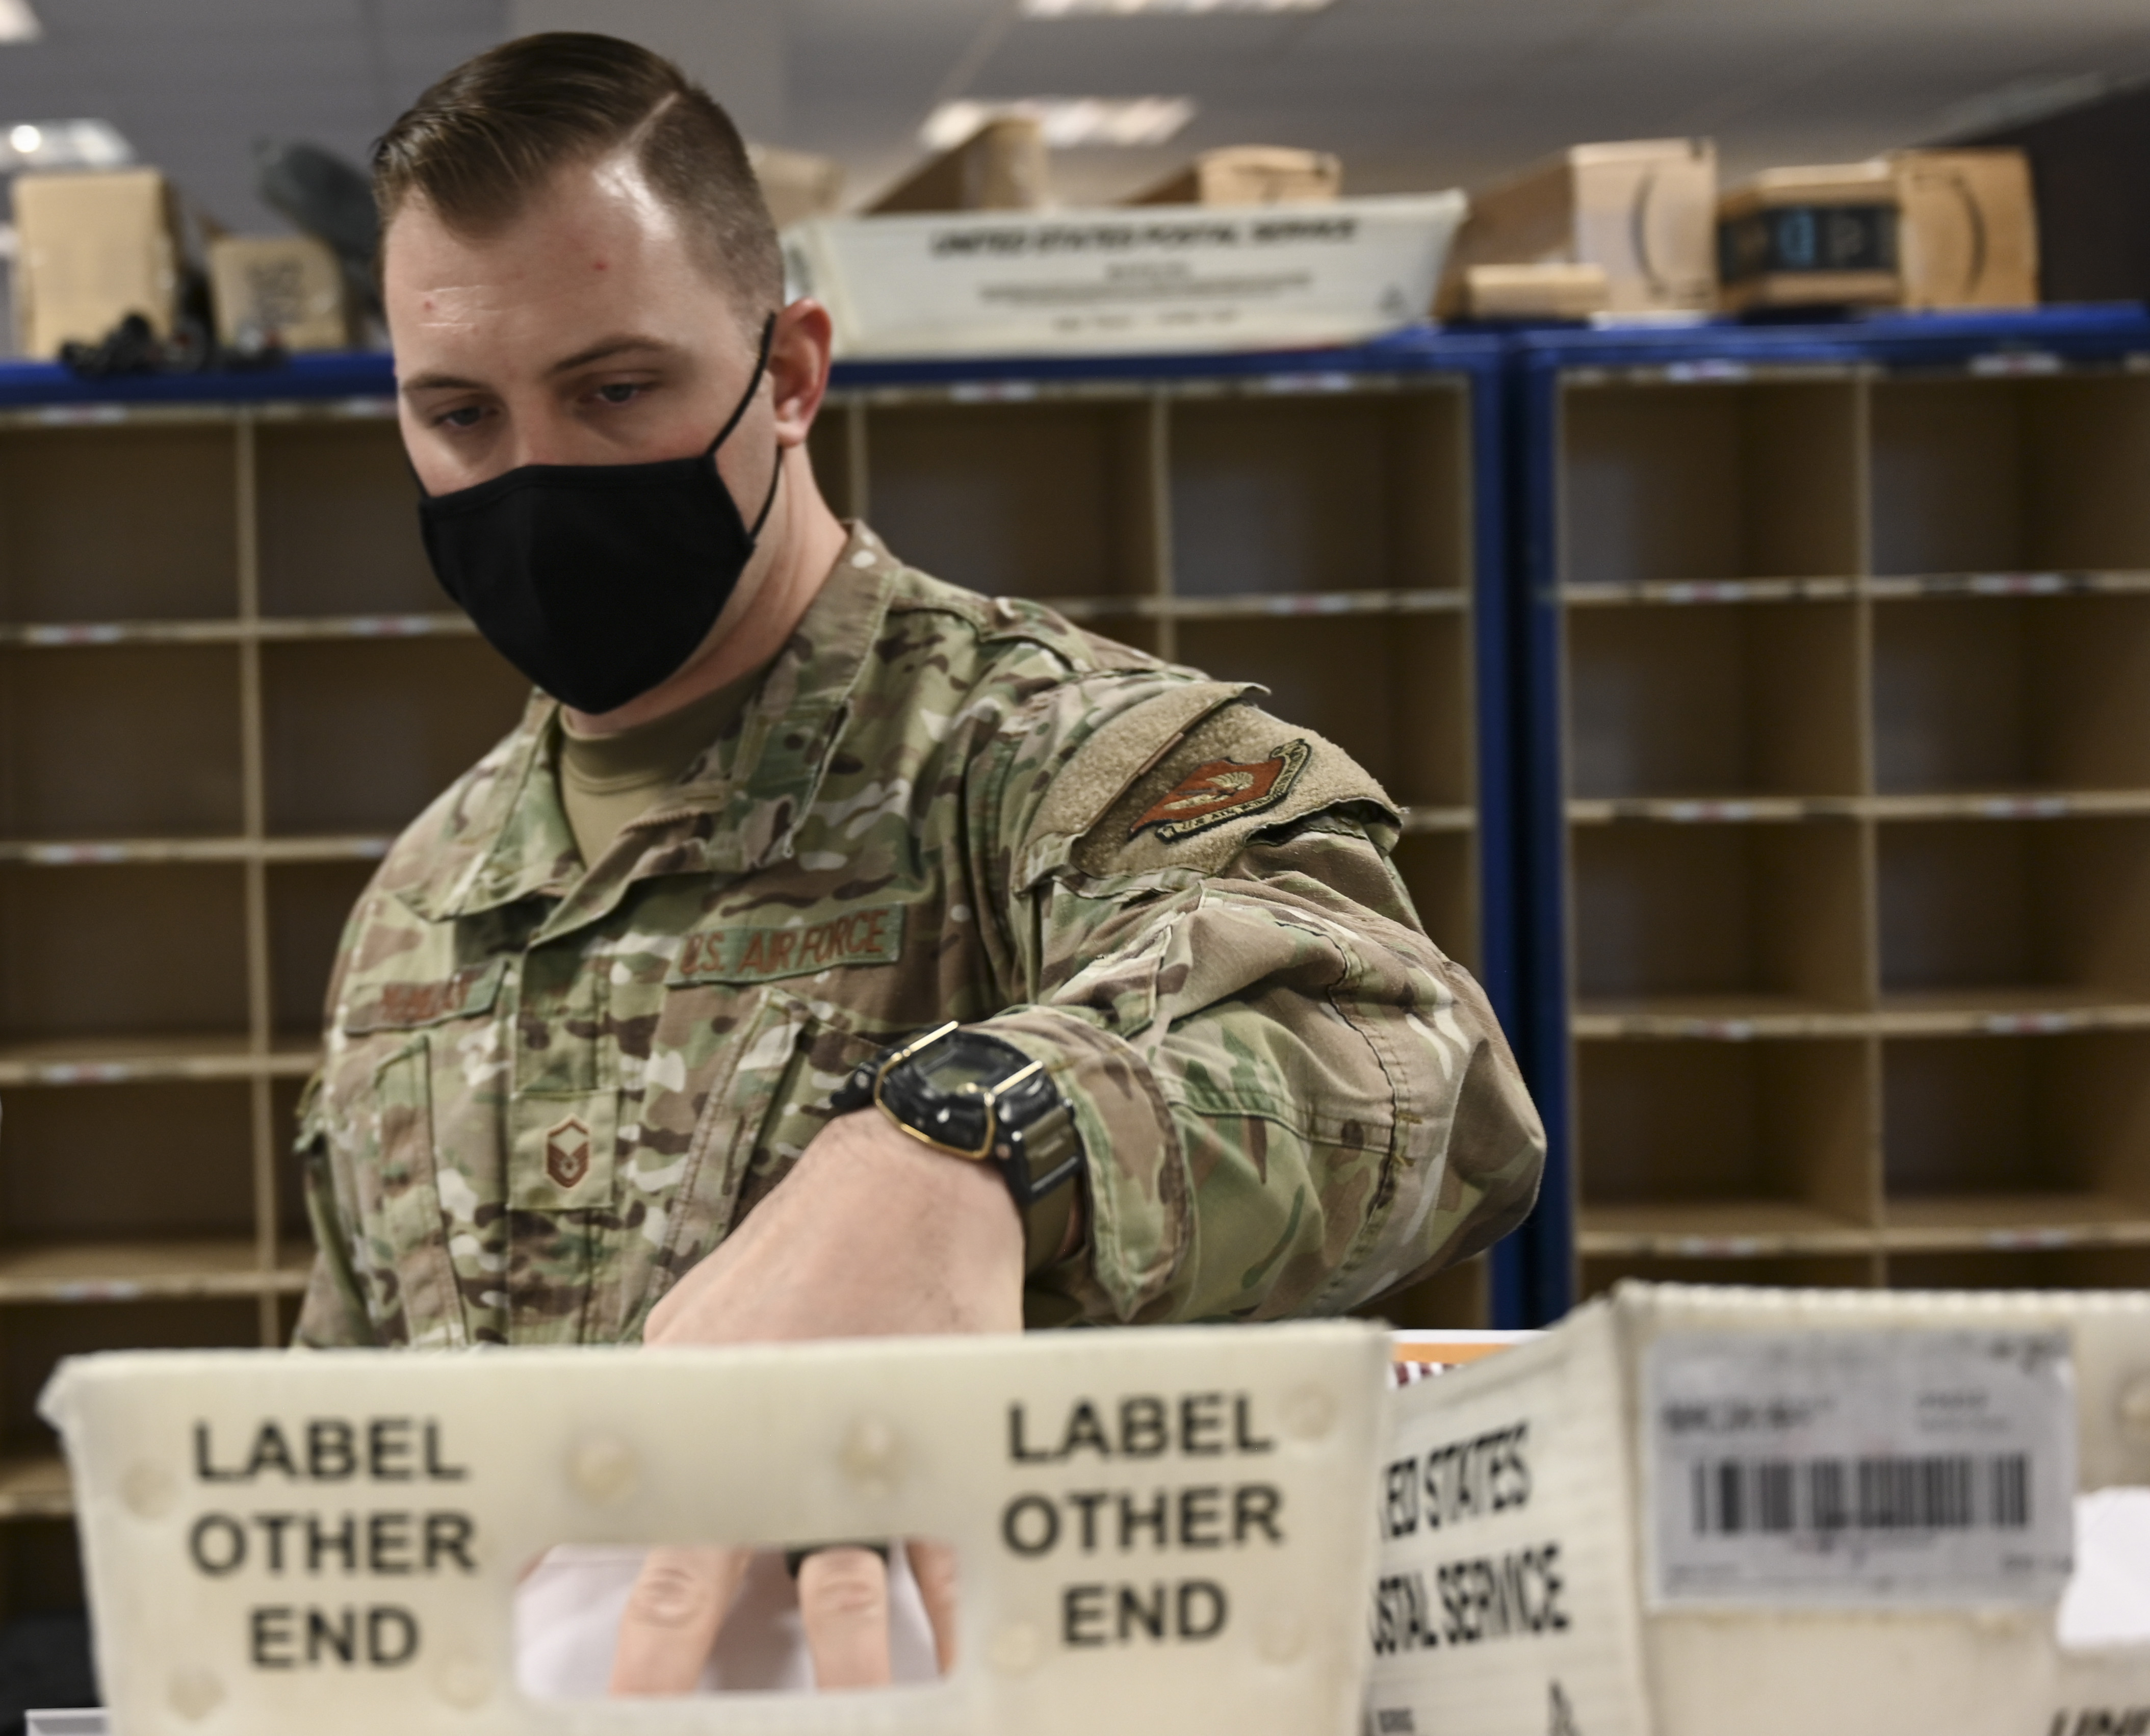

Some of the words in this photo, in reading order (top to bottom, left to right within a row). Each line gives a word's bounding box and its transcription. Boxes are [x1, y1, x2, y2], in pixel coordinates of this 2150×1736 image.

[737, 929, 797, 973] AIR
[794, 909, 889, 968] FORCE
[193, 1417, 468, 1484] LABEL
[1007, 1393, 1276, 1465] LABEL
[1379, 1452, 1419, 1540] ED
[1424, 1420, 1531, 1530] STATES
[189, 1510, 478, 1576] OTHER
[1000, 1481, 1285, 1560] OTHER
[1061, 1578, 1230, 1649] END
[1368, 1569, 1440, 1654] STAL
[1438, 1540, 1571, 1646] SERVICE
[250, 1603, 422, 1669] END
